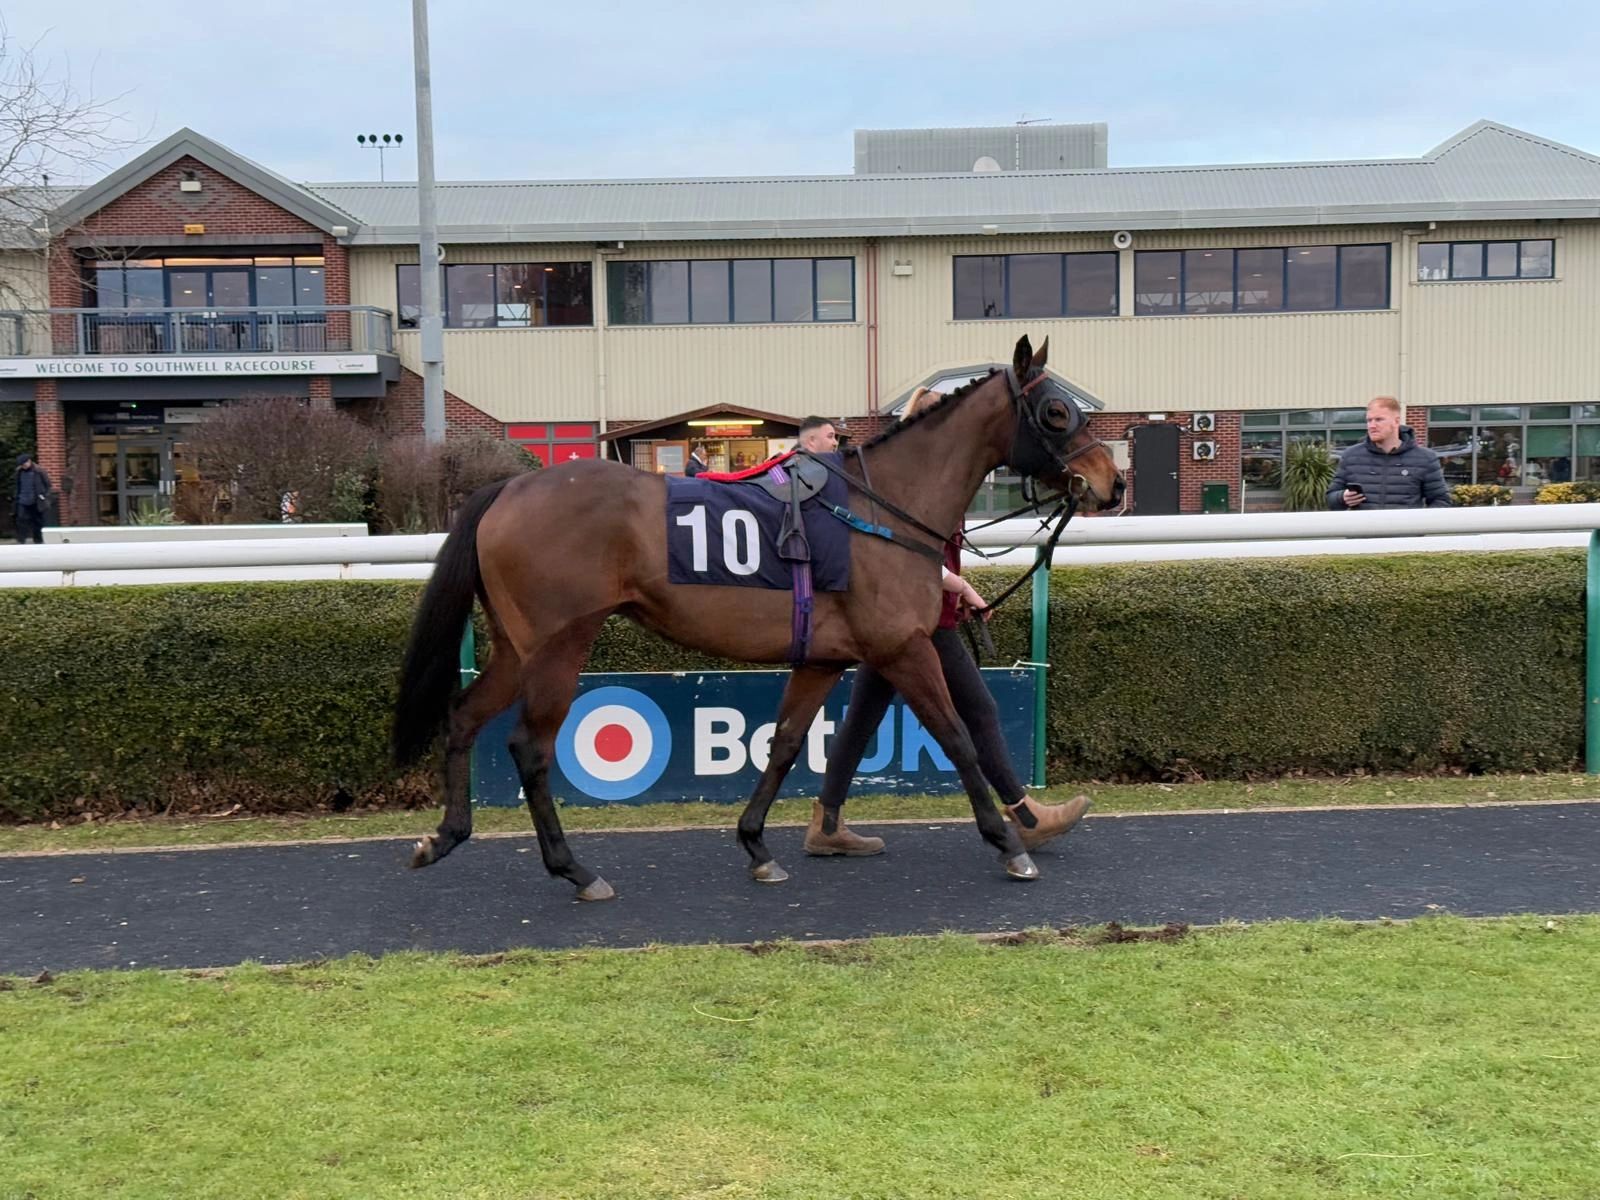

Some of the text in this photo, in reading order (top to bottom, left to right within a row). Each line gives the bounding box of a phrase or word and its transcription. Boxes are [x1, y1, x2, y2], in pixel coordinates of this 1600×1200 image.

[35, 359, 317, 374] WELCOME TO SOUTHWELL RACECOURSE
[676, 505, 760, 575] 10
